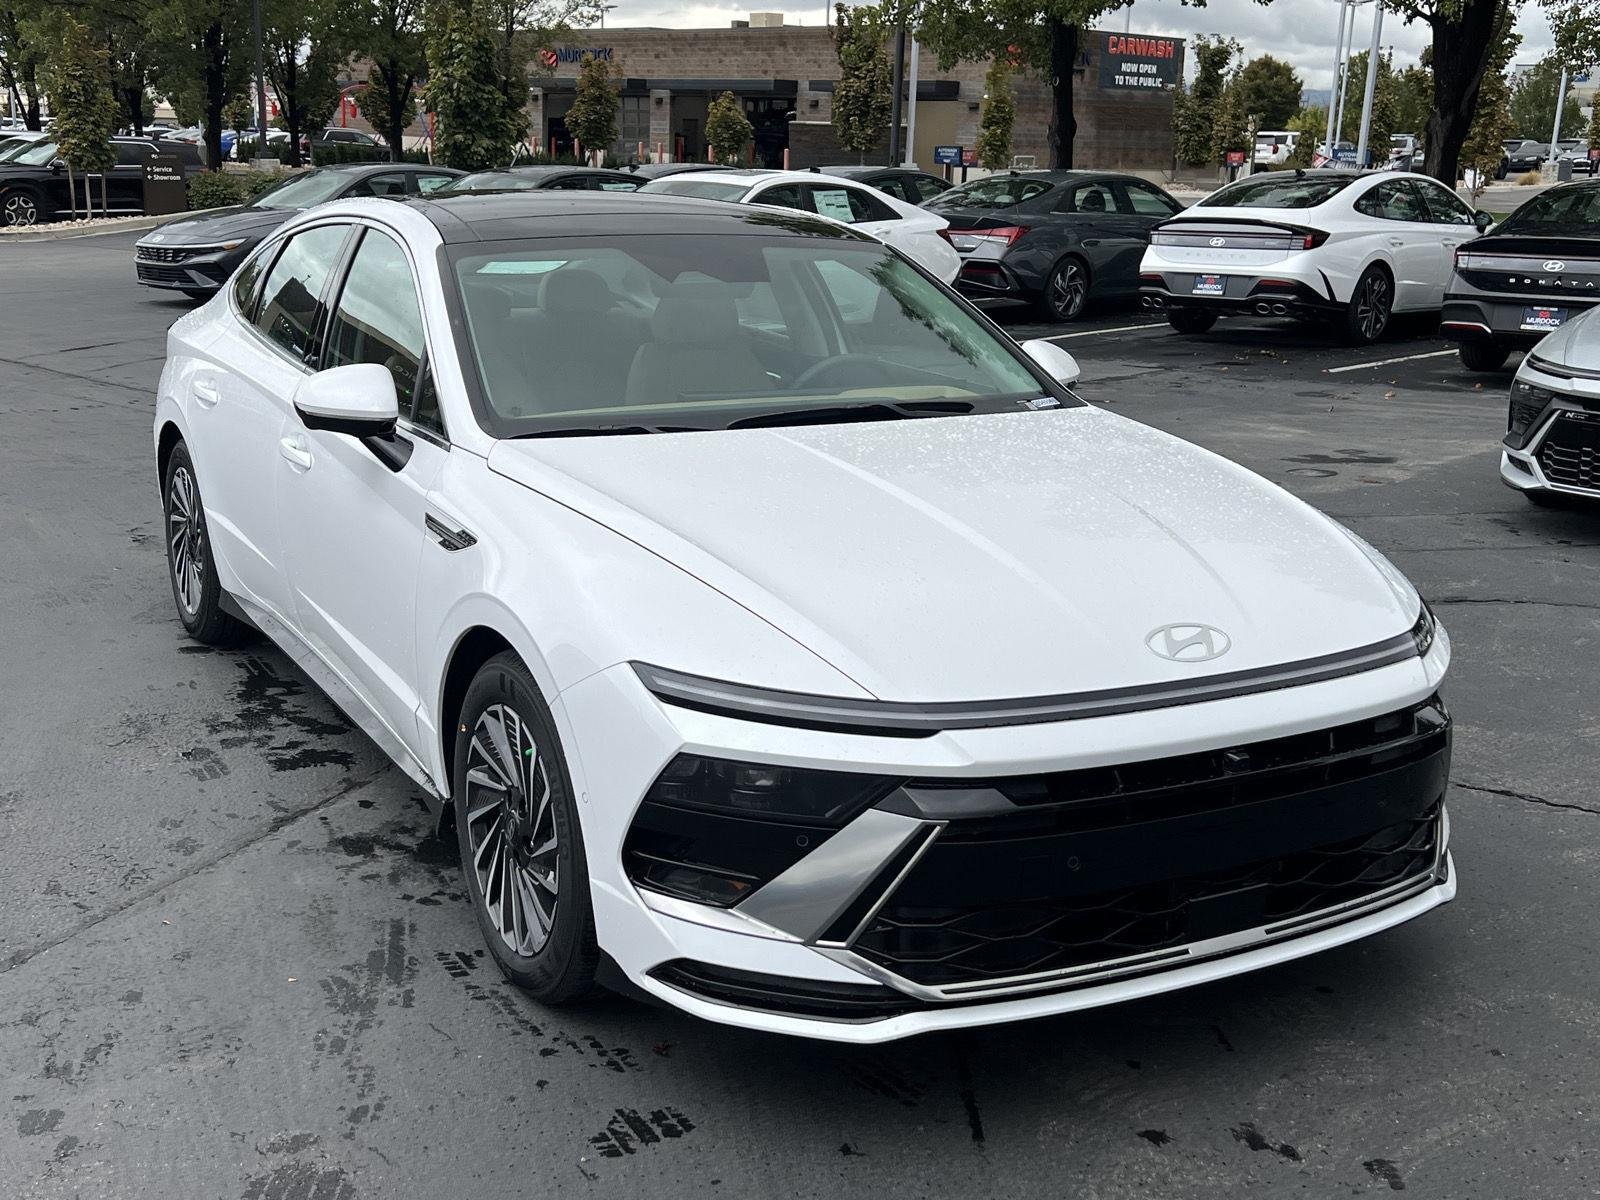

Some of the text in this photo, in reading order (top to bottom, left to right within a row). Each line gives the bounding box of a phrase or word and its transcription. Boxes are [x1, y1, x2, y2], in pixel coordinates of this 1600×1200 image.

[1108, 35, 1175, 58] CARWASH
[1121, 62, 1157, 74] NOW OPEN
[1114, 75, 1163, 87] TO THE PUBLIC
[1509, 278, 1594, 287] SONATA
[1525, 317, 1561, 325] MURDOCK
